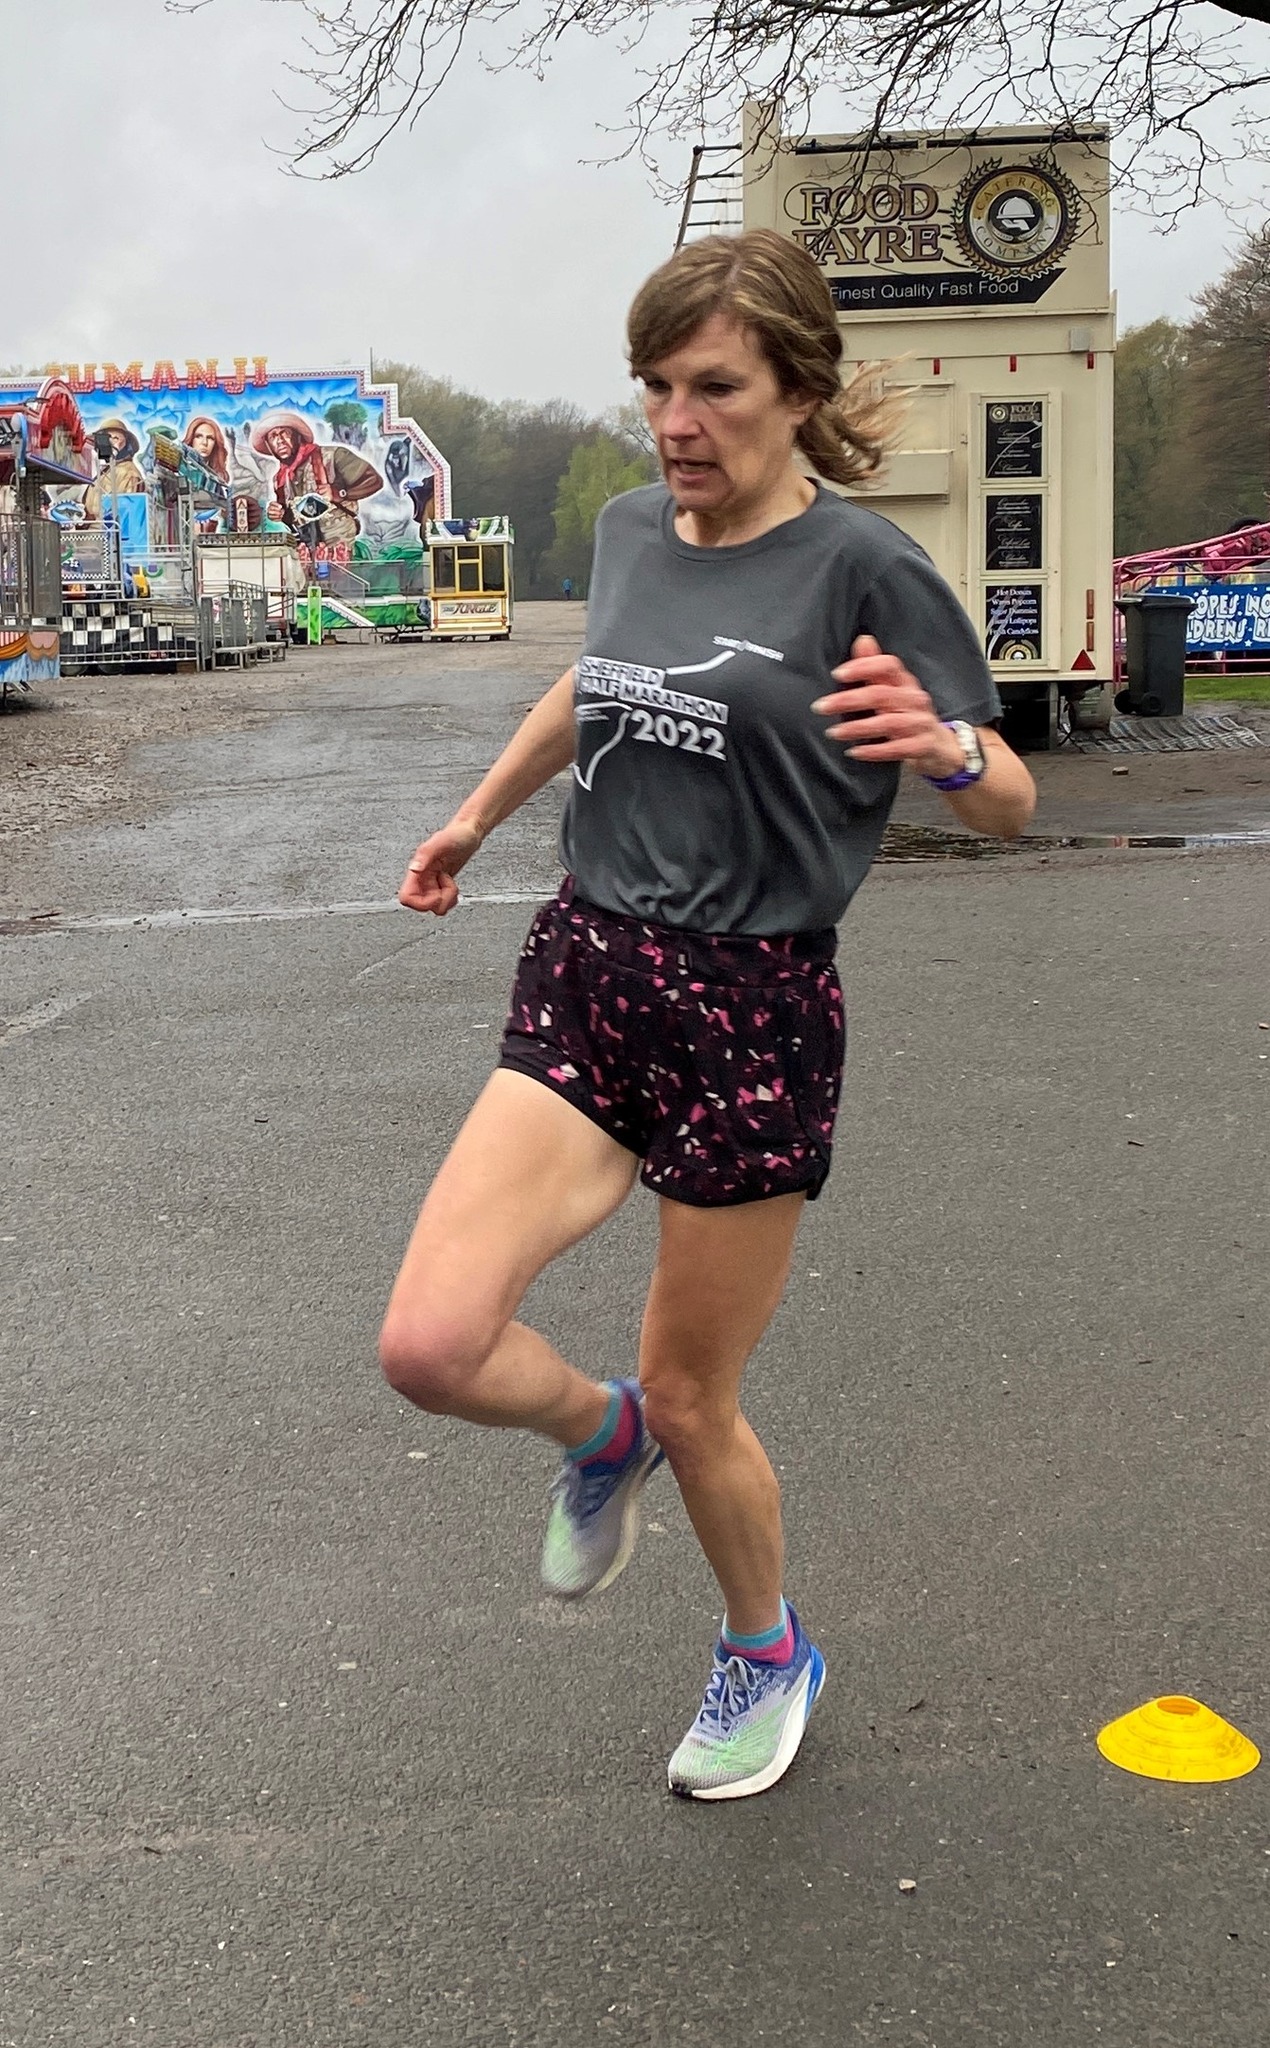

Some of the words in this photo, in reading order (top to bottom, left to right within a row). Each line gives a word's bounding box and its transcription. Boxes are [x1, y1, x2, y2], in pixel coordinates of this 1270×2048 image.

[800, 183, 939, 225] FOOD
[975, 176, 1055, 211] CATERING
[976, 226, 1054, 257] COMPANY
[830, 284, 875, 301] Finest
[881, 283, 937, 302] Quality
[939, 282, 974, 297] Fast
[979, 279, 1019, 296] Food
[581, 659, 662, 686] SHEFFIELD
[623, 682, 725, 723] MARATHON
[631, 708, 727, 761] 2022
